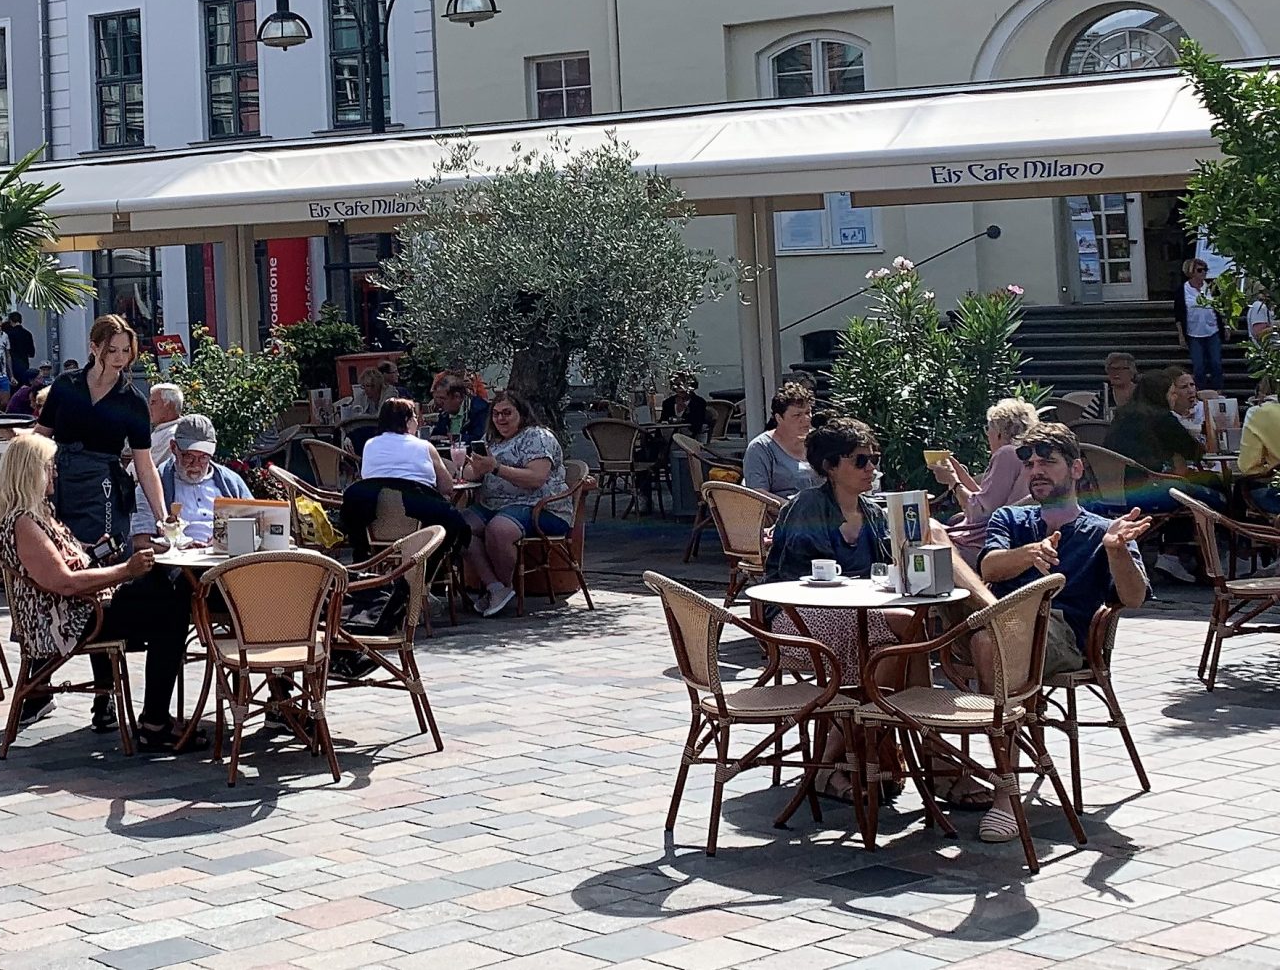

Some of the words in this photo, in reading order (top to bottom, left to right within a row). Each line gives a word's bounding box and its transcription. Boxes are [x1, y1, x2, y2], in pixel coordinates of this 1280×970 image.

[930, 165, 963, 184] Eis
[967, 162, 1019, 182] Cafe
[1023, 159, 1104, 179] Milano
[308, 202, 331, 219] Eis
[333, 200, 370, 217] Cafe
